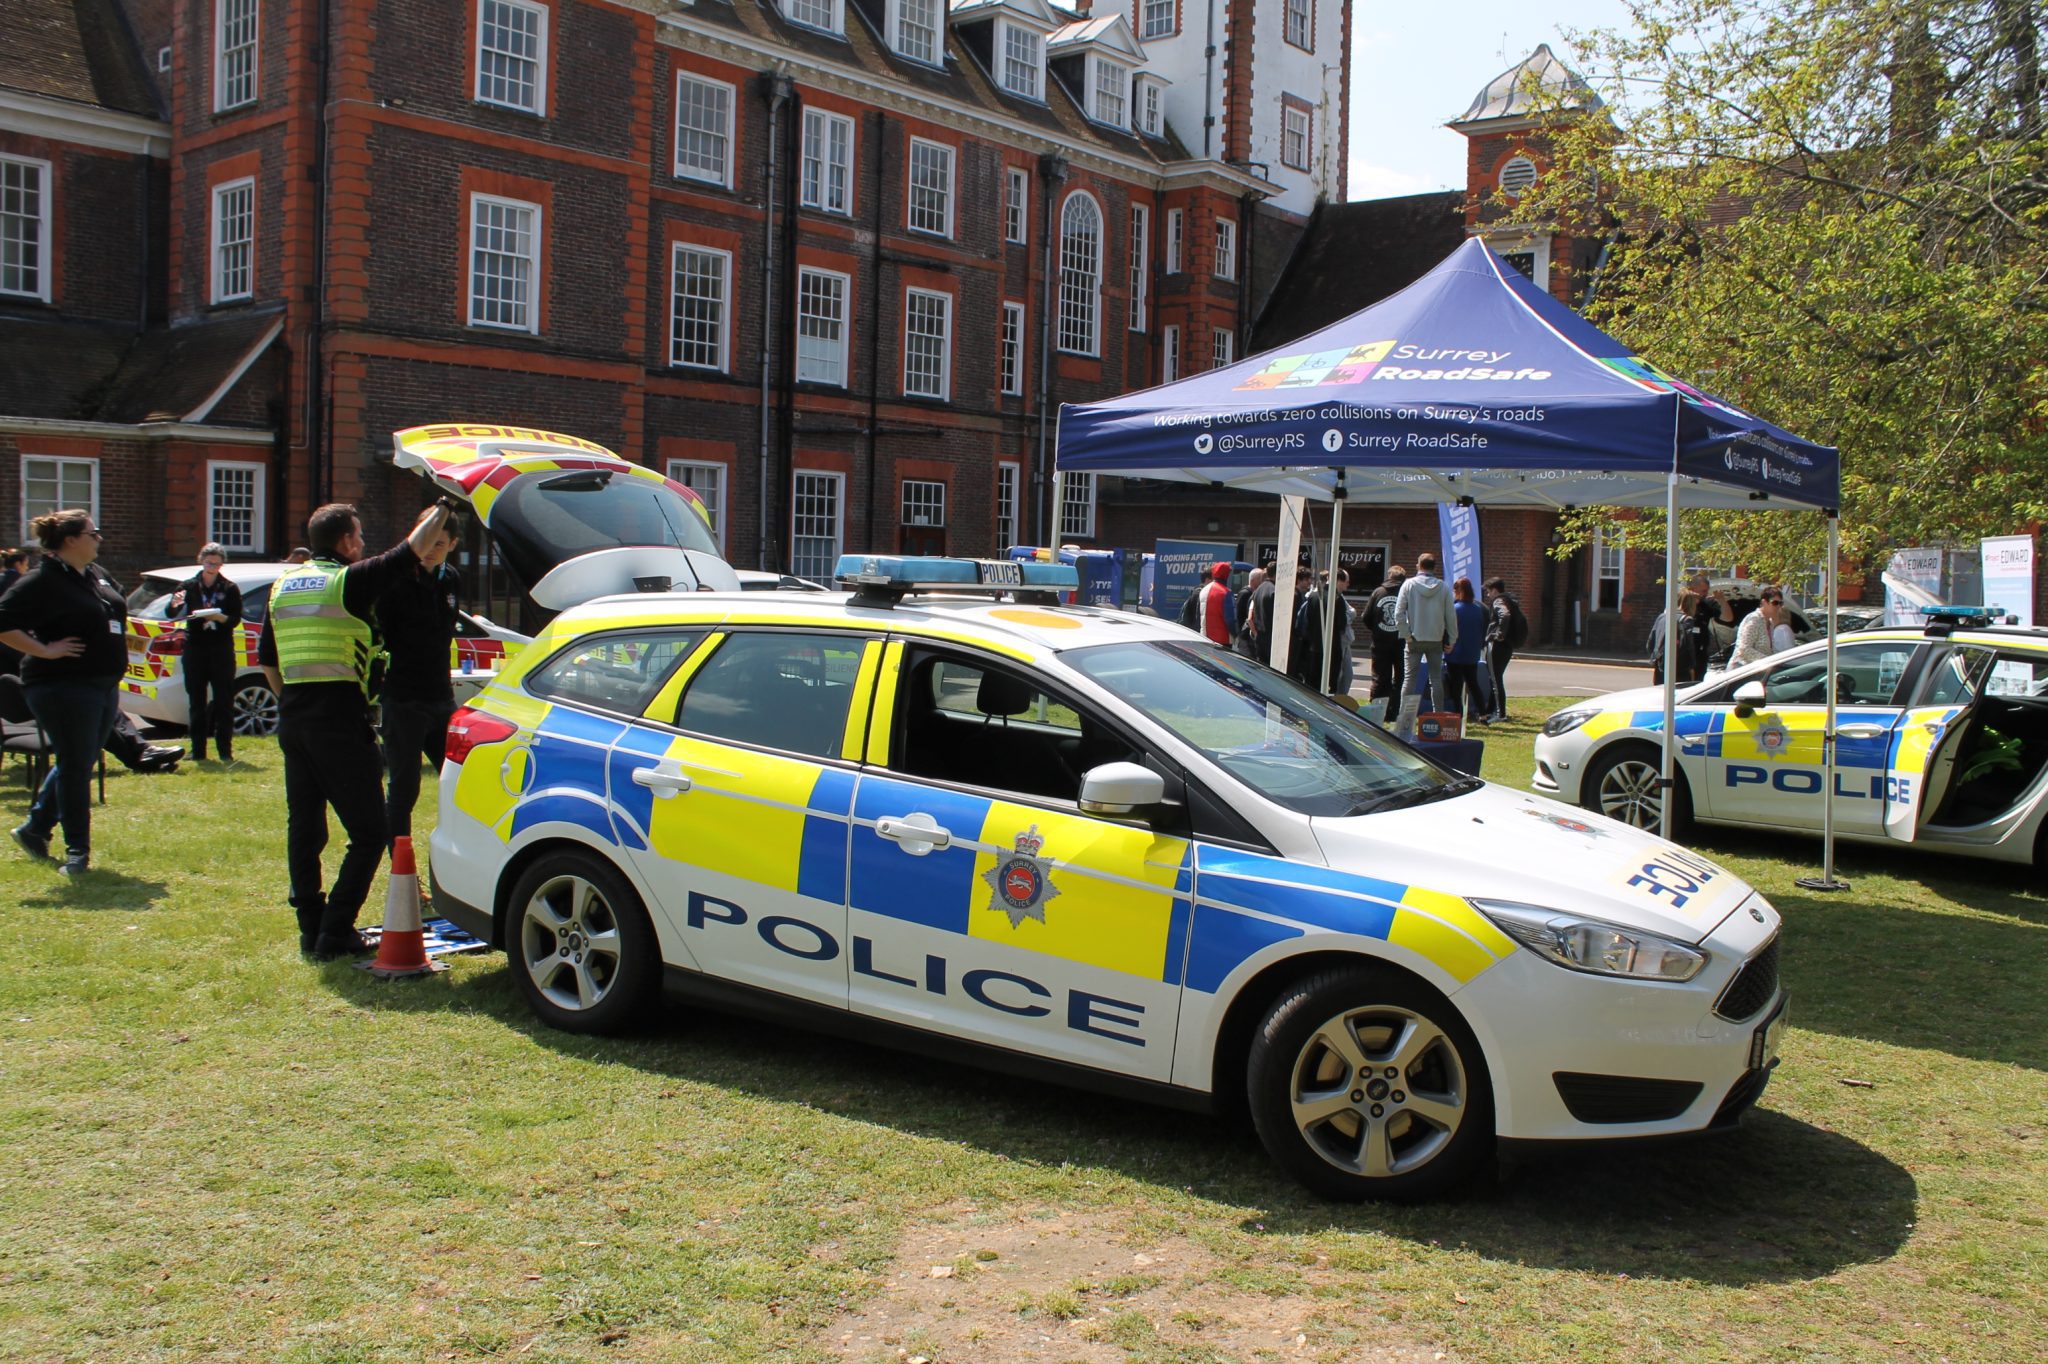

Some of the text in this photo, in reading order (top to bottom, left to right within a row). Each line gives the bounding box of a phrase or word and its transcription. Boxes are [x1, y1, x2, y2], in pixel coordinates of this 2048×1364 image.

[1393, 345, 1512, 364] Surrey
[1372, 366, 1553, 381] RoadSafe
[1153, 404, 1545, 429] Working towards zero collisions on Surrey's roads
[424, 427, 610, 455] POLICE
[1218, 432, 1306, 453] @SurreyRS
[1348, 432, 1402, 451] Surrey
[1406, 432, 1488, 449] RoadSafe
[1159, 552, 1213, 563] LOOKING AFTER
[1338, 550, 1382, 566] nspire
[1907, 557, 1938, 570] EDWARD
[2001, 548, 2029, 564] EDWARD
[982, 563, 1019, 585] POLICE
[1166, 562, 1196, 575] YOUR
[283, 577, 326, 592] POLICE
[1726, 764, 1910, 804] POLICE
[1008, 860, 1038, 874] SURREY
[1004, 894, 1031, 907] POLICE
[687, 890, 1146, 1047] POLICE
